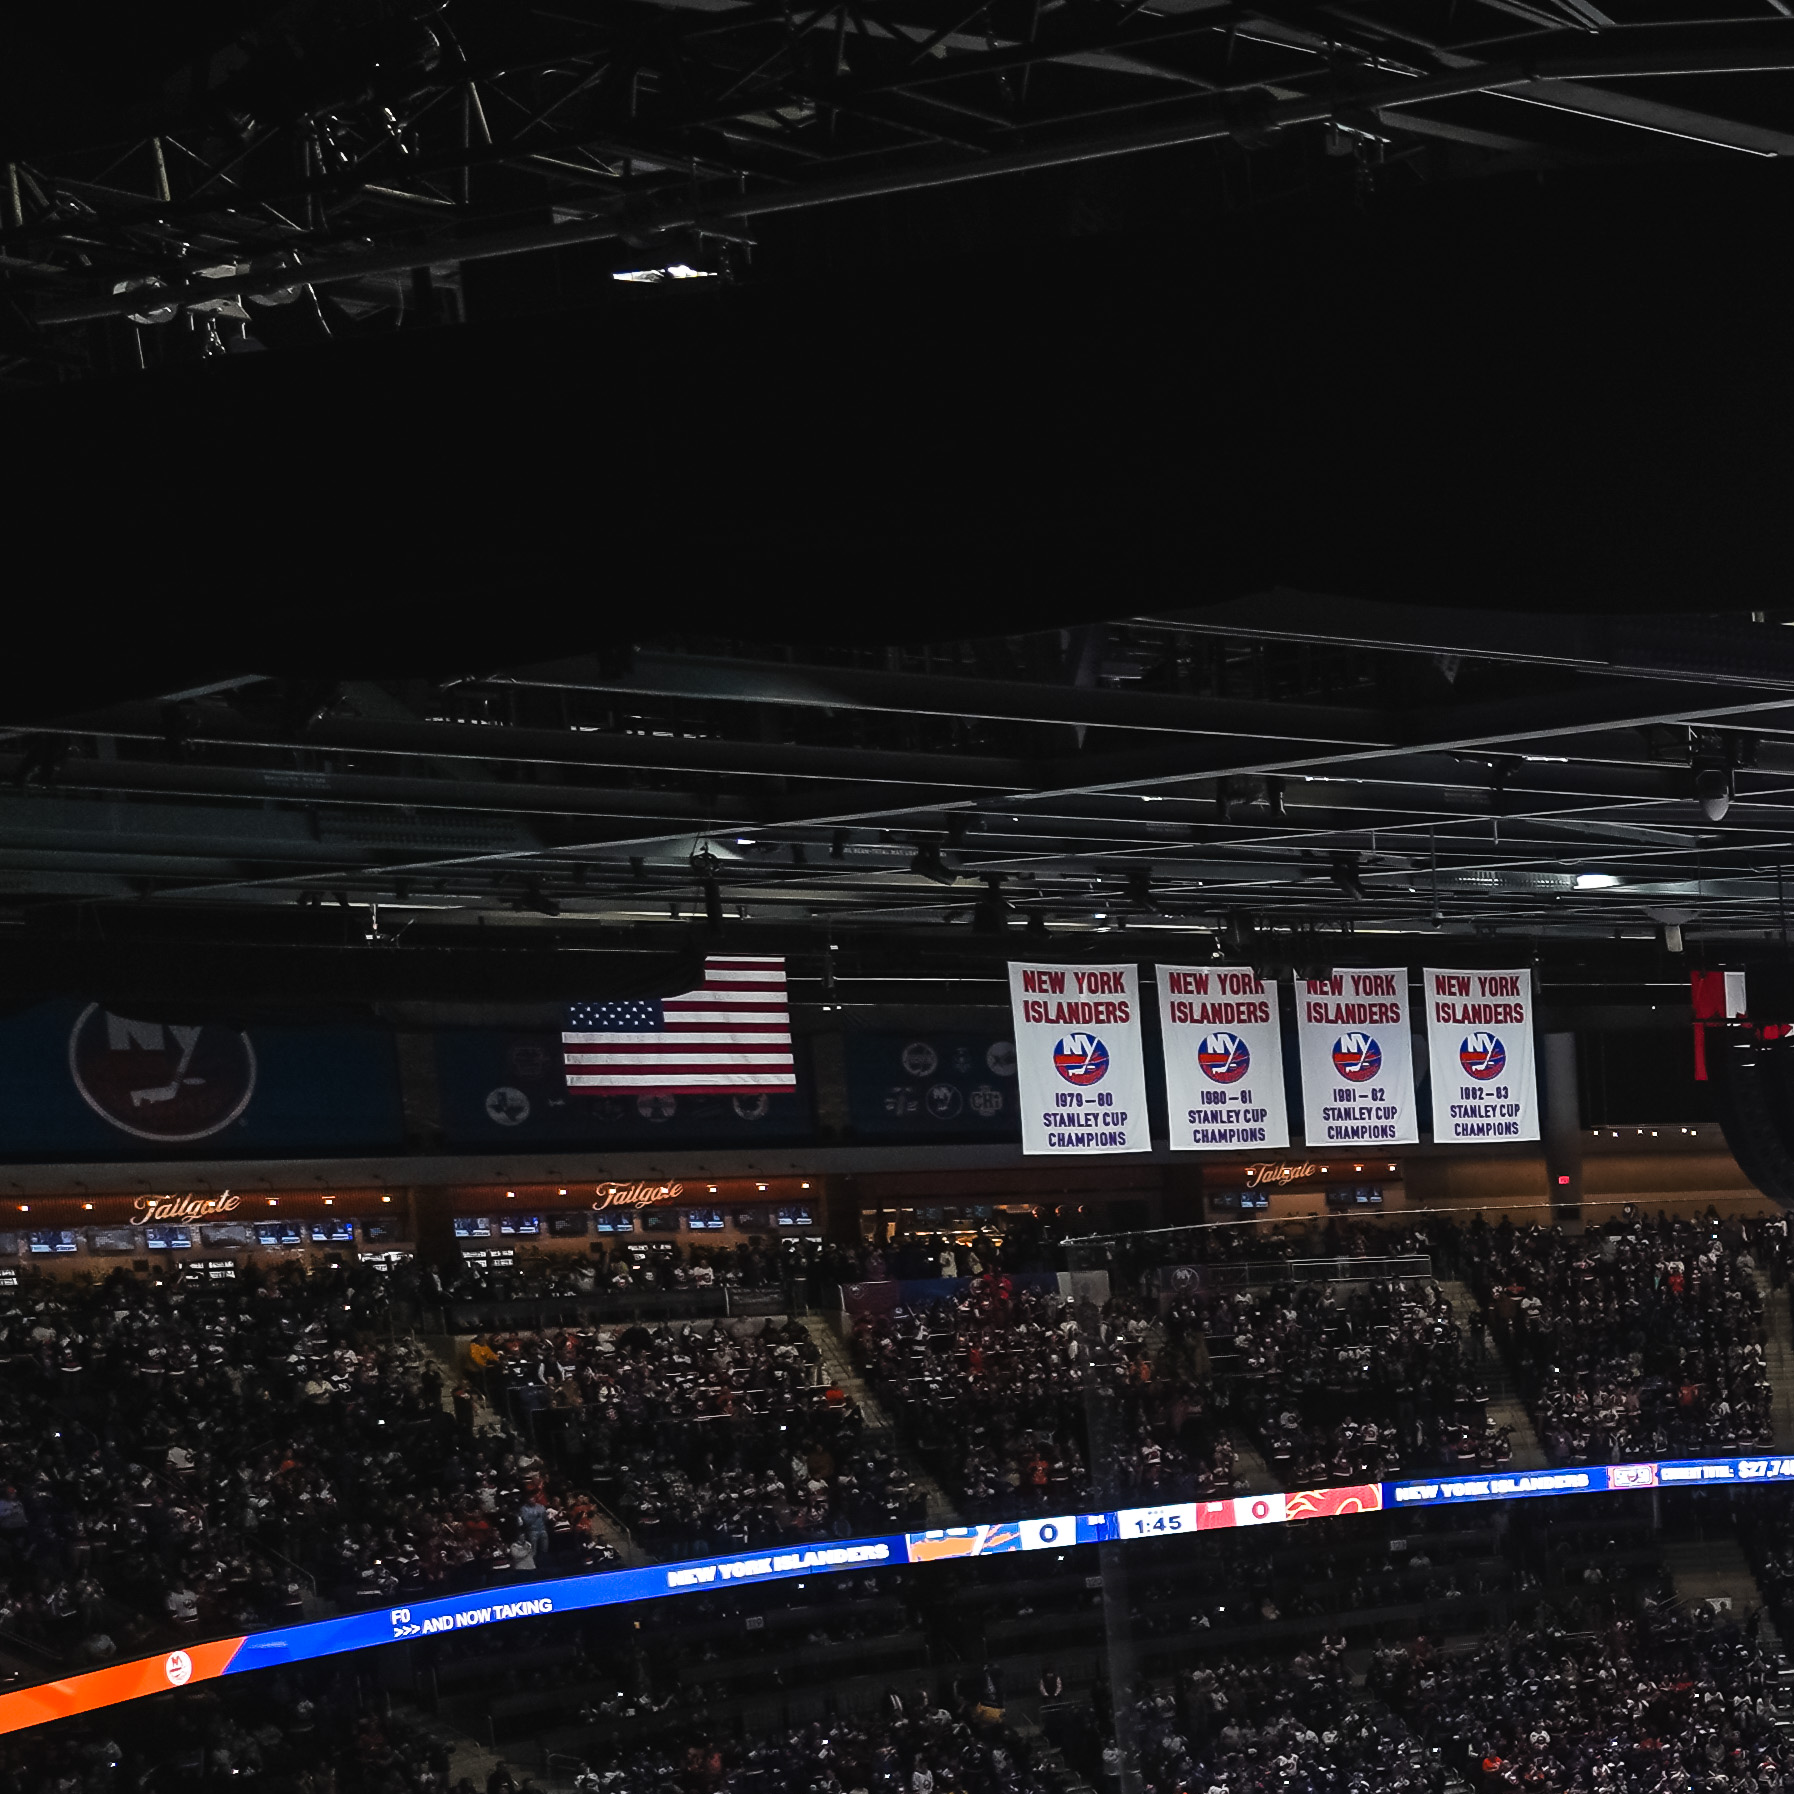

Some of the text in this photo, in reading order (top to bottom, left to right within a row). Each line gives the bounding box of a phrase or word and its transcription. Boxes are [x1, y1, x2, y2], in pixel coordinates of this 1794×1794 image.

[1023, 970, 1125, 994] NEW YORK
[1169, 972, 1209, 995] NEW
[1351, 975, 1397, 996] YORK
[1435, 975, 1521, 997] NEW YORK
[1023, 1000, 1130, 1024] ISLANDERS
[1170, 1001, 1270, 1024] ISLANDERS
[1306, 1002, 1401, 1025] ISLANDERS
[1435, 1002, 1524, 1024] ISLANDERS
[1043, 1112, 1128, 1128] STANLEY CUP
[1188, 1109, 1268, 1124] STANLEY CUP
[1323, 1106, 1397, 1122] STANLEY CUP
[1450, 1104, 1521, 1119] STANLEY CUP
[1048, 1131, 1126, 1147] CHAMPIONS
[1193, 1128, 1266, 1144] CHAMPIONS
[1327, 1125, 1396, 1140] CHAMPIONS
[1454, 1122, 1520, 1137] CHAMPIONS
[593, 1179, 684, 1211] Tailgate
[130, 1189, 241, 1226] Tailgate
[1396, 1484, 1437, 1502] NEW
[1440, 1479, 1486, 1498] YORK
[1488, 1472, 1590, 1496] ISLANDERS
[1251, 1501, 1270, 1520] 0
[1039, 1523, 1059, 1543] 0
[1134, 1515, 1183, 1535] 1:45
[667, 1543, 890, 1589] NEW YORK ISLANDERS
[422, 1597, 554, 1635] AND NOW TAKING
